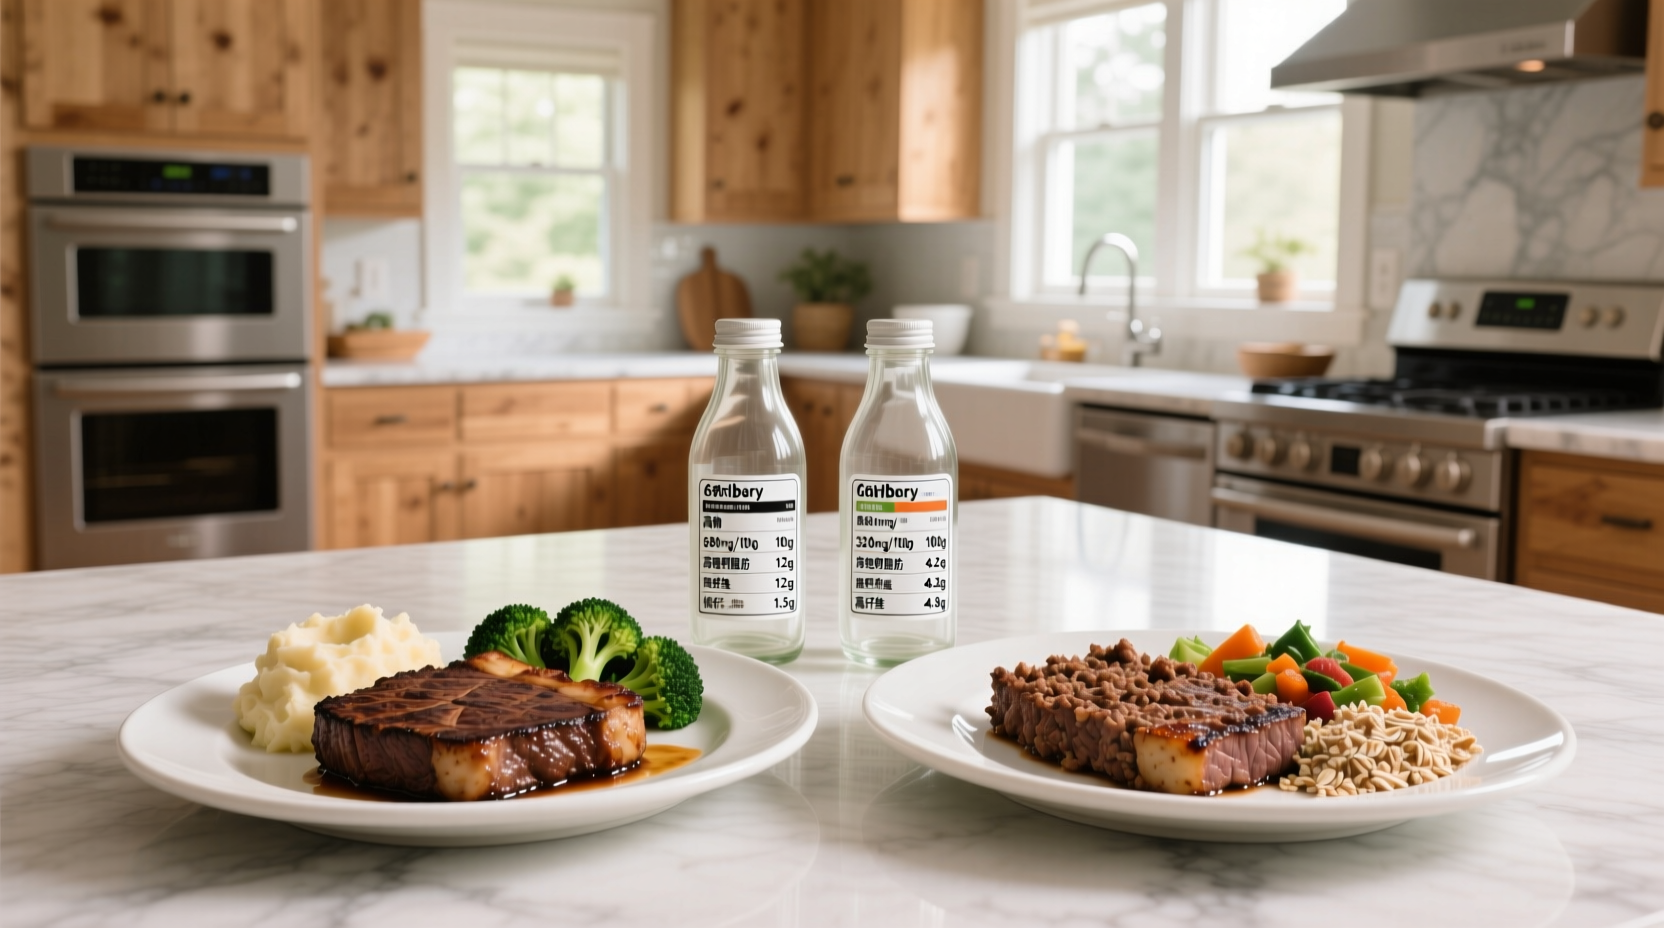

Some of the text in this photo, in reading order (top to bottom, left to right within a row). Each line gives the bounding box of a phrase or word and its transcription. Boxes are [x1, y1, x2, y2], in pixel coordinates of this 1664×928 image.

[776, 557, 794, 571] 12g
[775, 577, 794, 591] 12g
[774, 597, 795, 610] 1.5g
